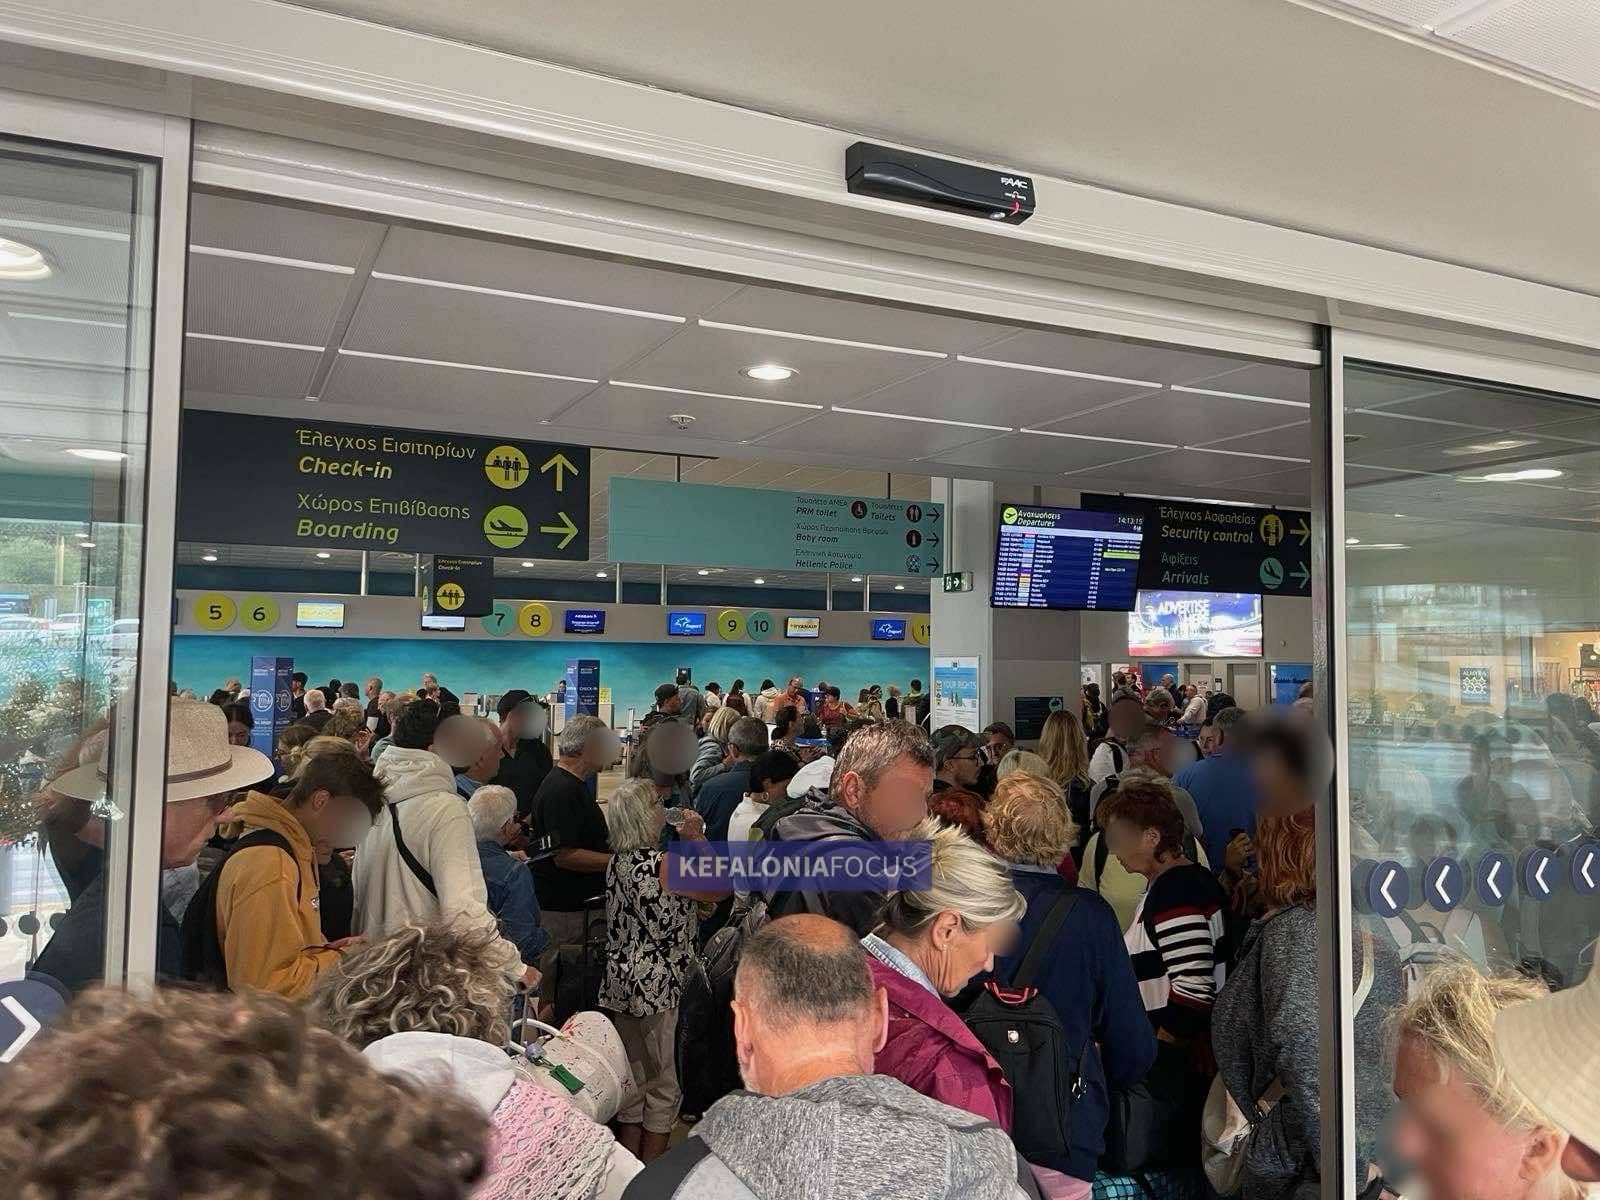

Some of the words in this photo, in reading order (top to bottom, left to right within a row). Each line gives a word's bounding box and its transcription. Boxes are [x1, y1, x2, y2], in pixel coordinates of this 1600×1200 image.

[296, 429, 377, 452] Έλεγχος
[383, 437, 475, 459] Εισιτηρίων
[299, 456, 393, 480] Check-in
[298, 493, 363, 514] Χώρος
[370, 499, 471, 521] Επιβίβασης
[796, 507, 814, 516] PRM
[816, 508, 837, 517] toilet
[1158, 505, 1202, 523] Έλεγχος
[871, 512, 896, 521] Toilets
[1018, 518, 1056, 528] Departures
[297, 519, 399, 544] Boarding
[1161, 526, 1209, 544] Security
[1213, 529, 1254, 544] control
[818, 536, 839, 544] room
[796, 560, 827, 569] Hellenic
[830, 561, 854, 570] Police
[1161, 552, 1199, 568] Αφίξεις
[1162, 572, 1209, 586] Arrivals
[209, 605, 222, 620] 5
[253, 606, 266, 622] 6
[494, 614, 506, 627] 7
[530, 614, 542, 628] 8
[728, 620, 737, 633] 9
[754, 620, 770, 633] 10
